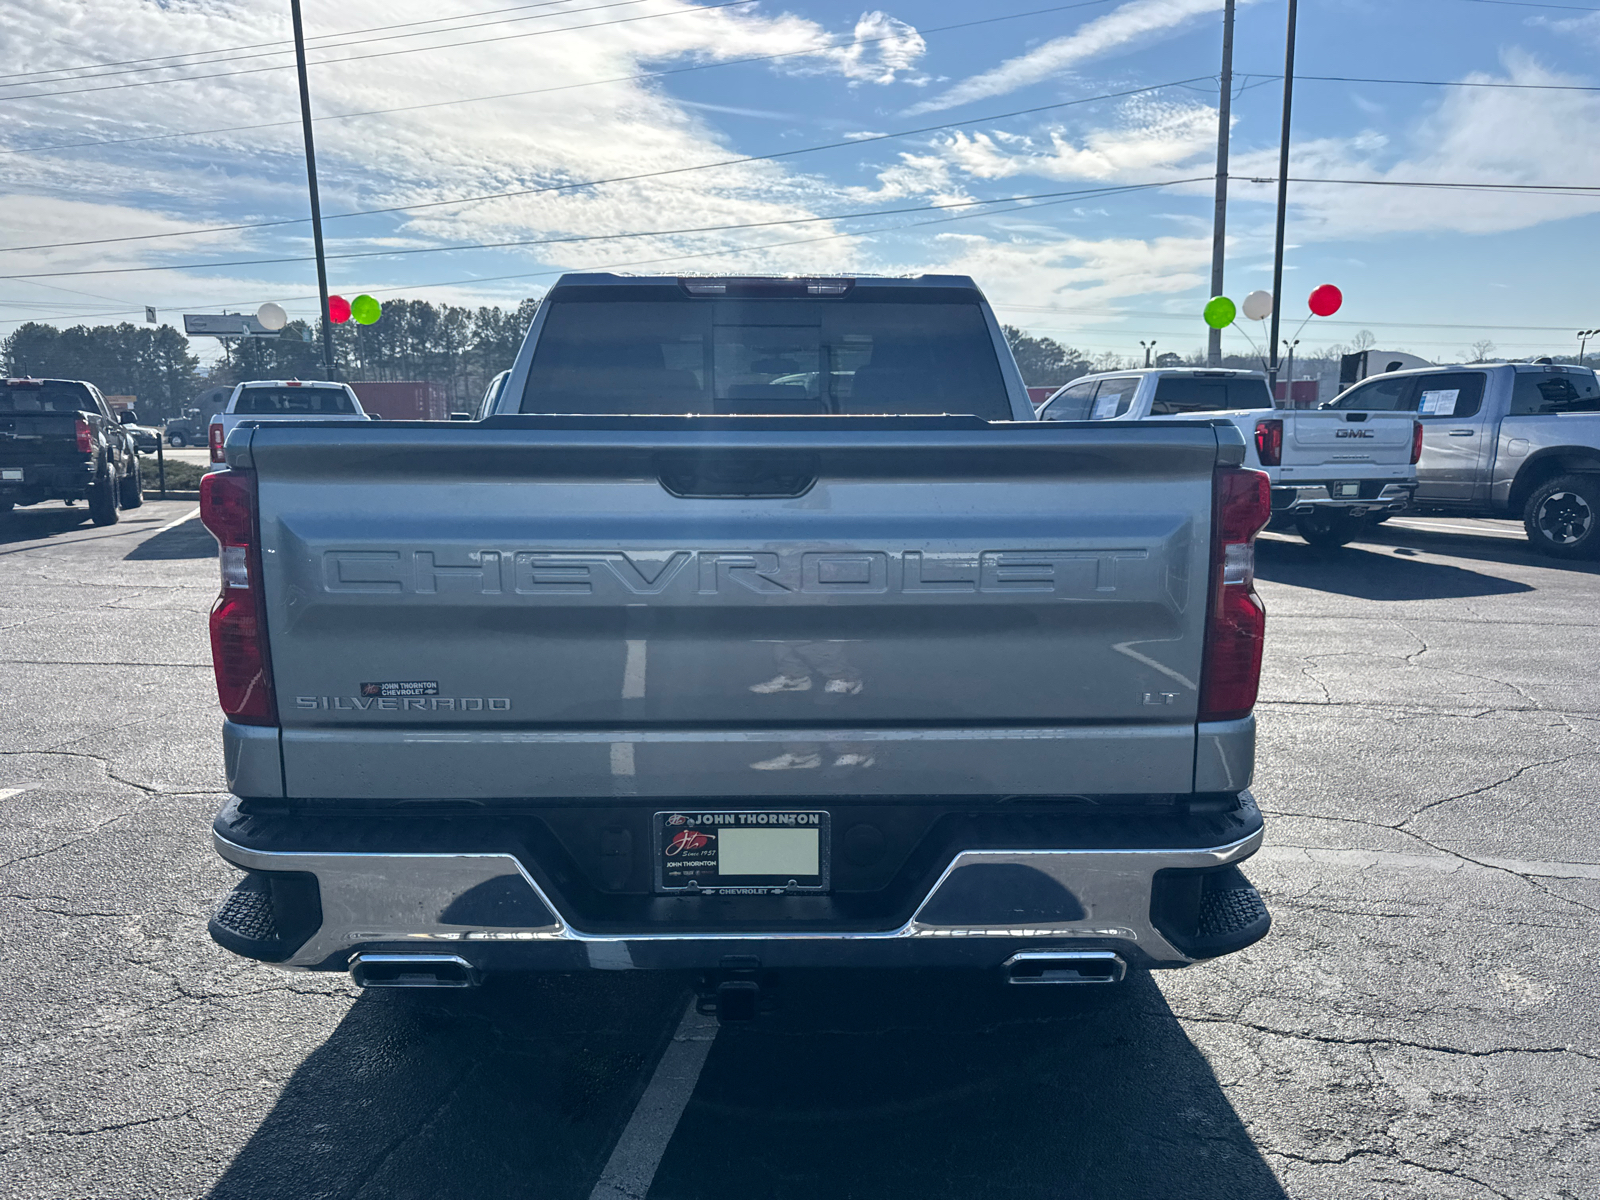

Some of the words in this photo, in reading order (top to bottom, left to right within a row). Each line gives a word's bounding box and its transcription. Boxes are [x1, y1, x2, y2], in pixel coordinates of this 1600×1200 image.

[1335, 428, 1375, 438] GMC
[323, 549, 1149, 594] CHEVROLET
[381, 688, 424, 696] CHEVROLET
[1142, 691, 1180, 705] LT
[295, 696, 512, 711] SILVERADO
[695, 814, 735, 825] JOHN
[738, 813, 819, 825] THORNTON
